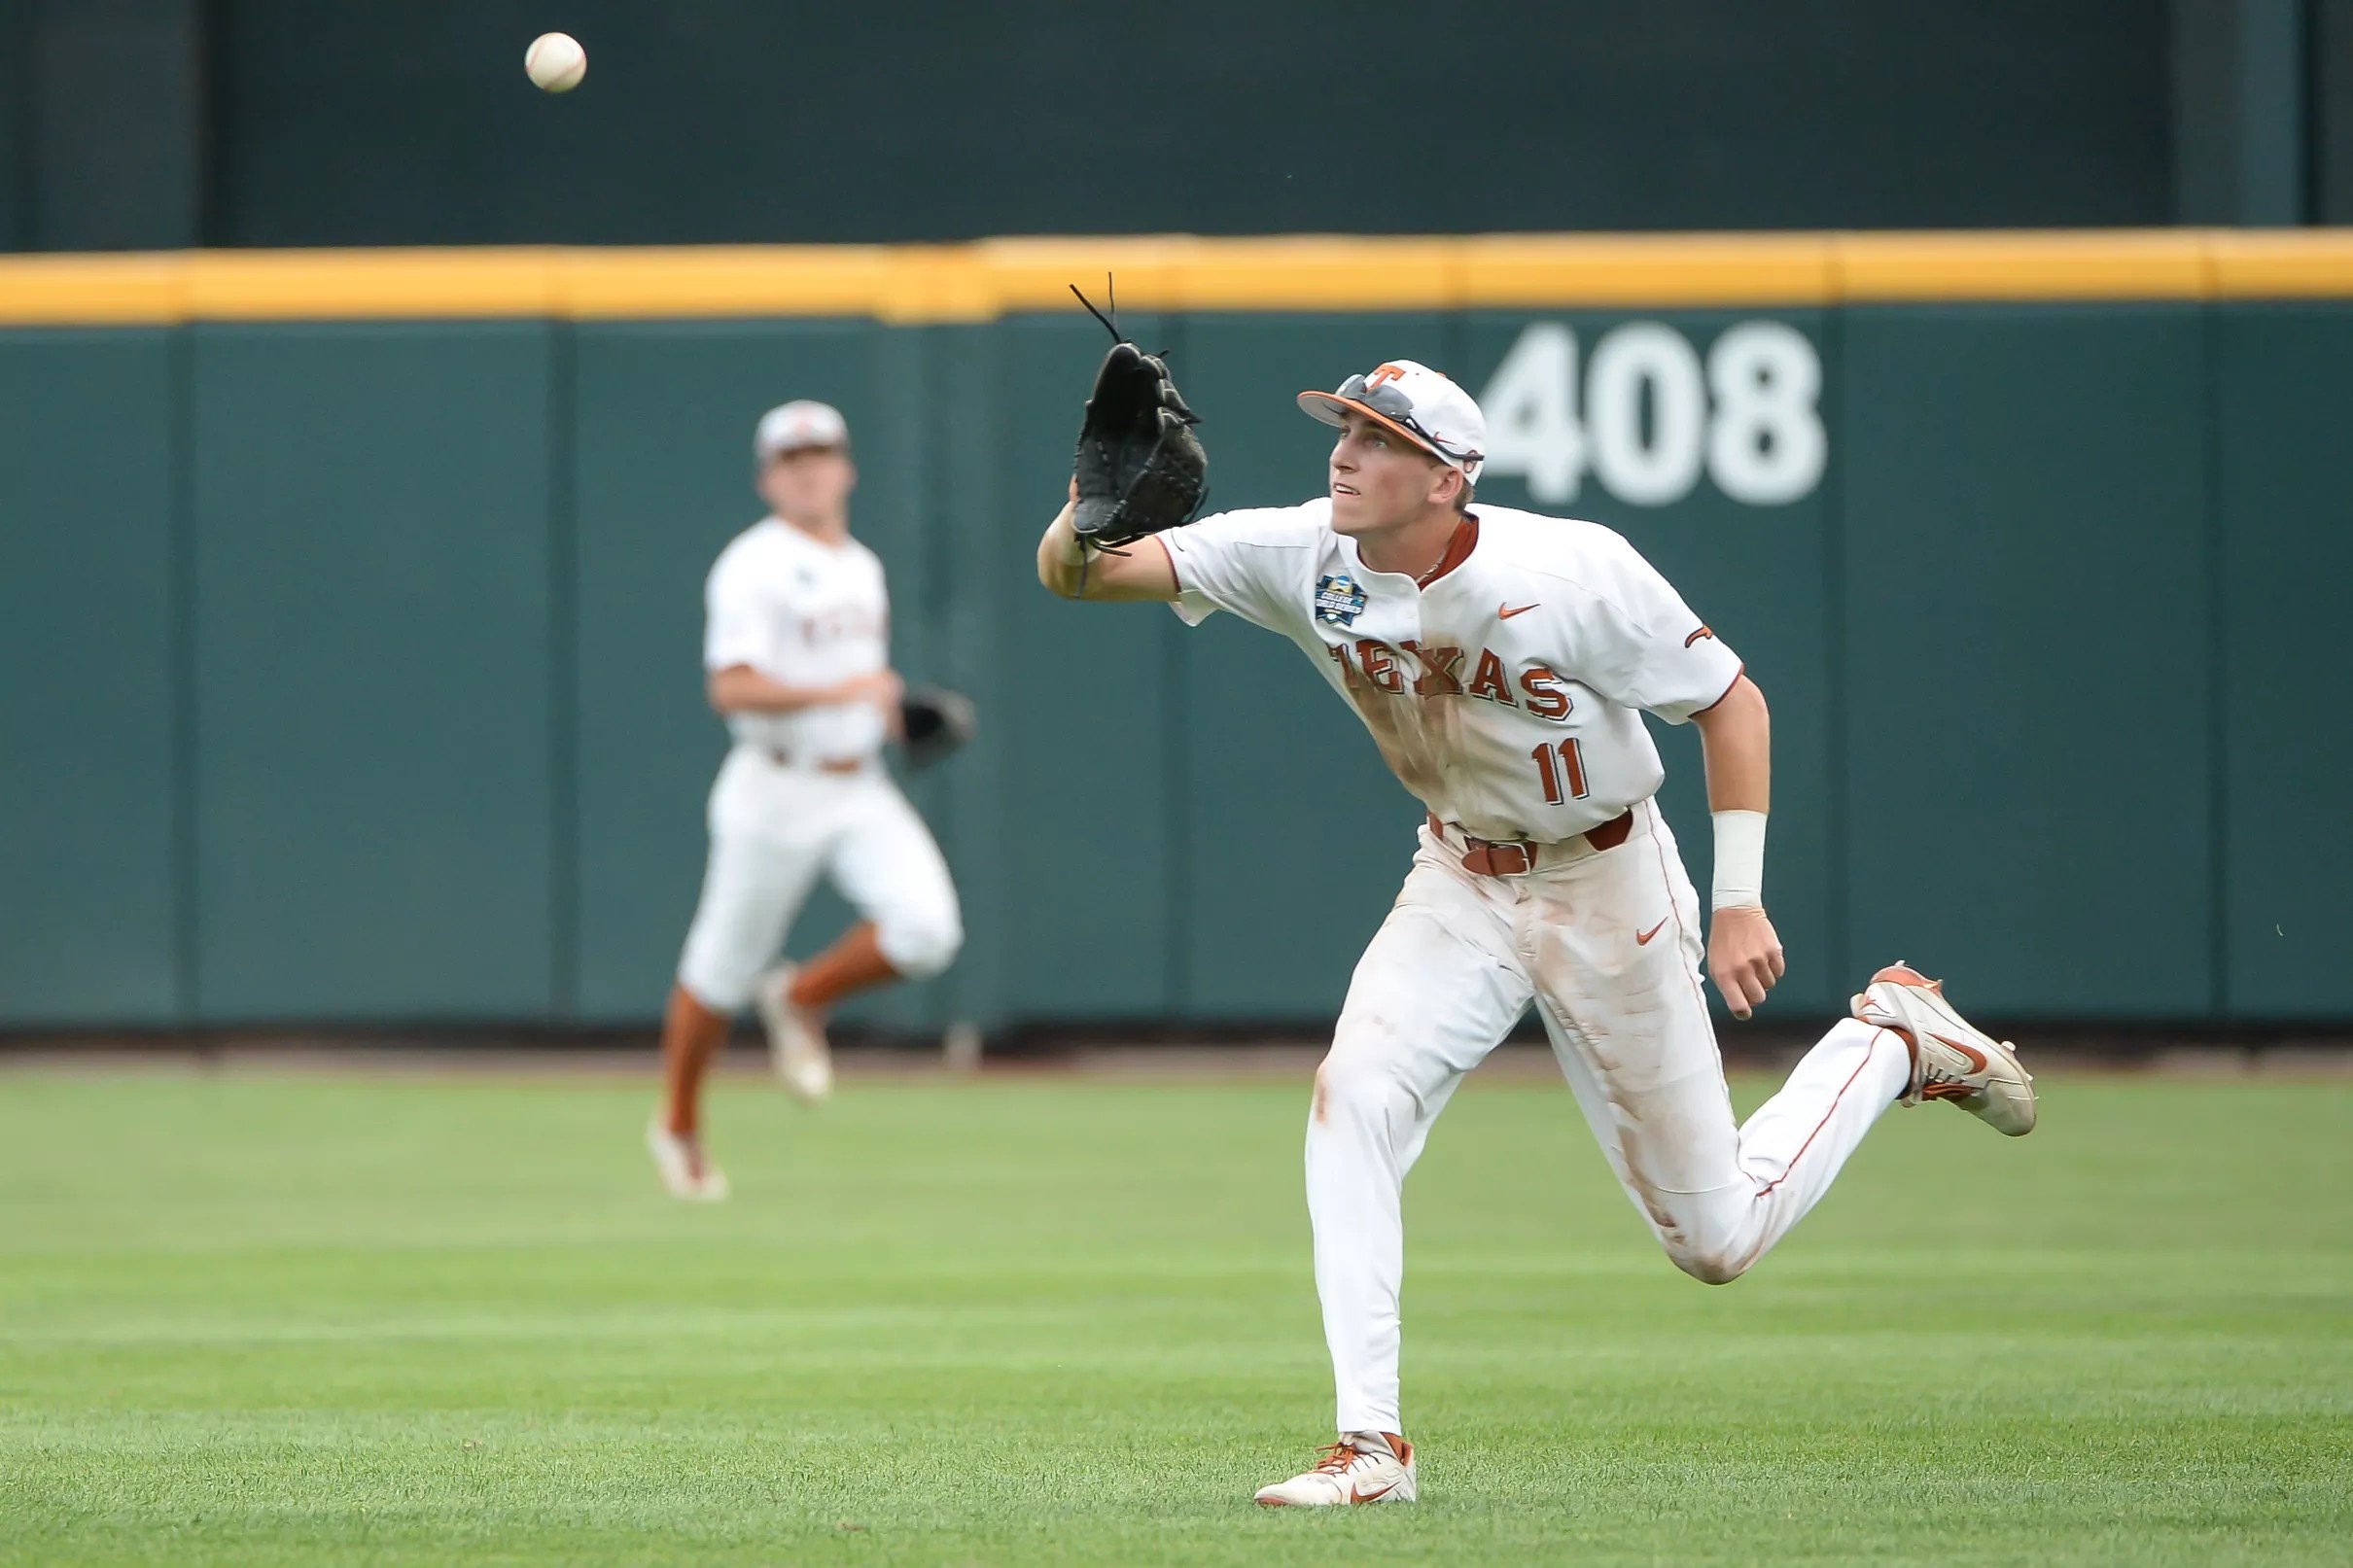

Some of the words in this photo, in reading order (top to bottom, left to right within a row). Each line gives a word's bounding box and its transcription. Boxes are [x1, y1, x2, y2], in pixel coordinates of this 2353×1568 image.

[1368, 364, 1406, 391] T
[1477, 320, 1828, 506] 408
[1326, 638, 1574, 722] TEXAS
[1531, 737, 1590, 806] 11
